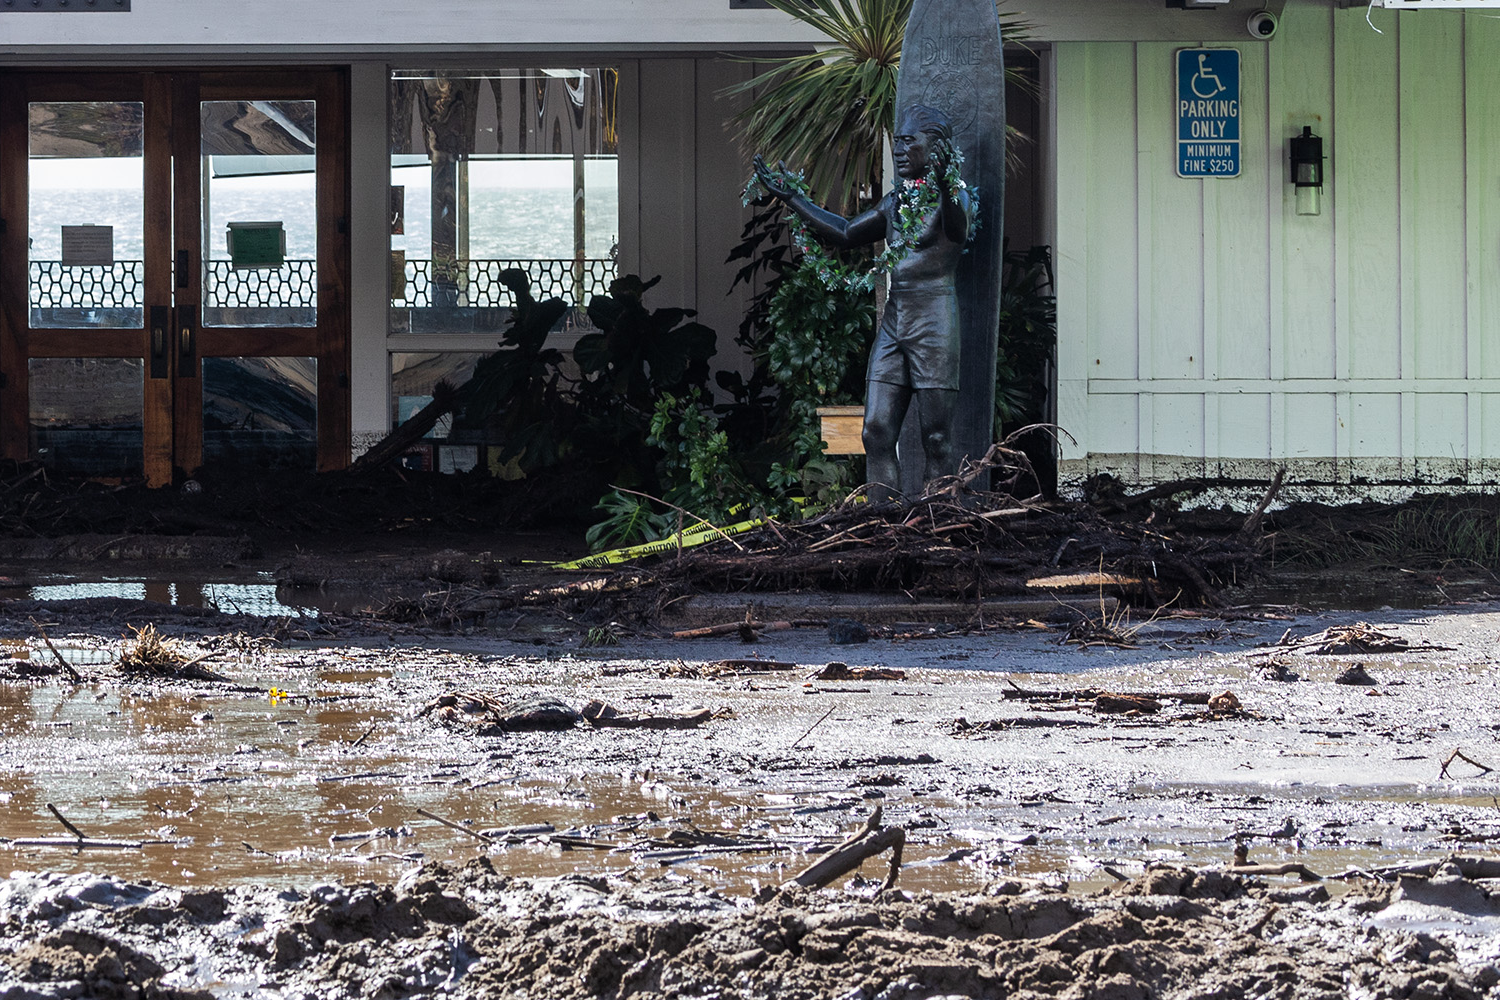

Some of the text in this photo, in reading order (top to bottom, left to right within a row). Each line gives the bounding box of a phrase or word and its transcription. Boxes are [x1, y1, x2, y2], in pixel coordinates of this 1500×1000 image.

[920, 36, 982, 67] DUKE
[1180, 100, 1238, 118] PARKING
[1191, 120, 1226, 138] ONLY
[1187, 144, 1231, 157] MINIMUM
[1184, 158, 1234, 173] FINE $250
